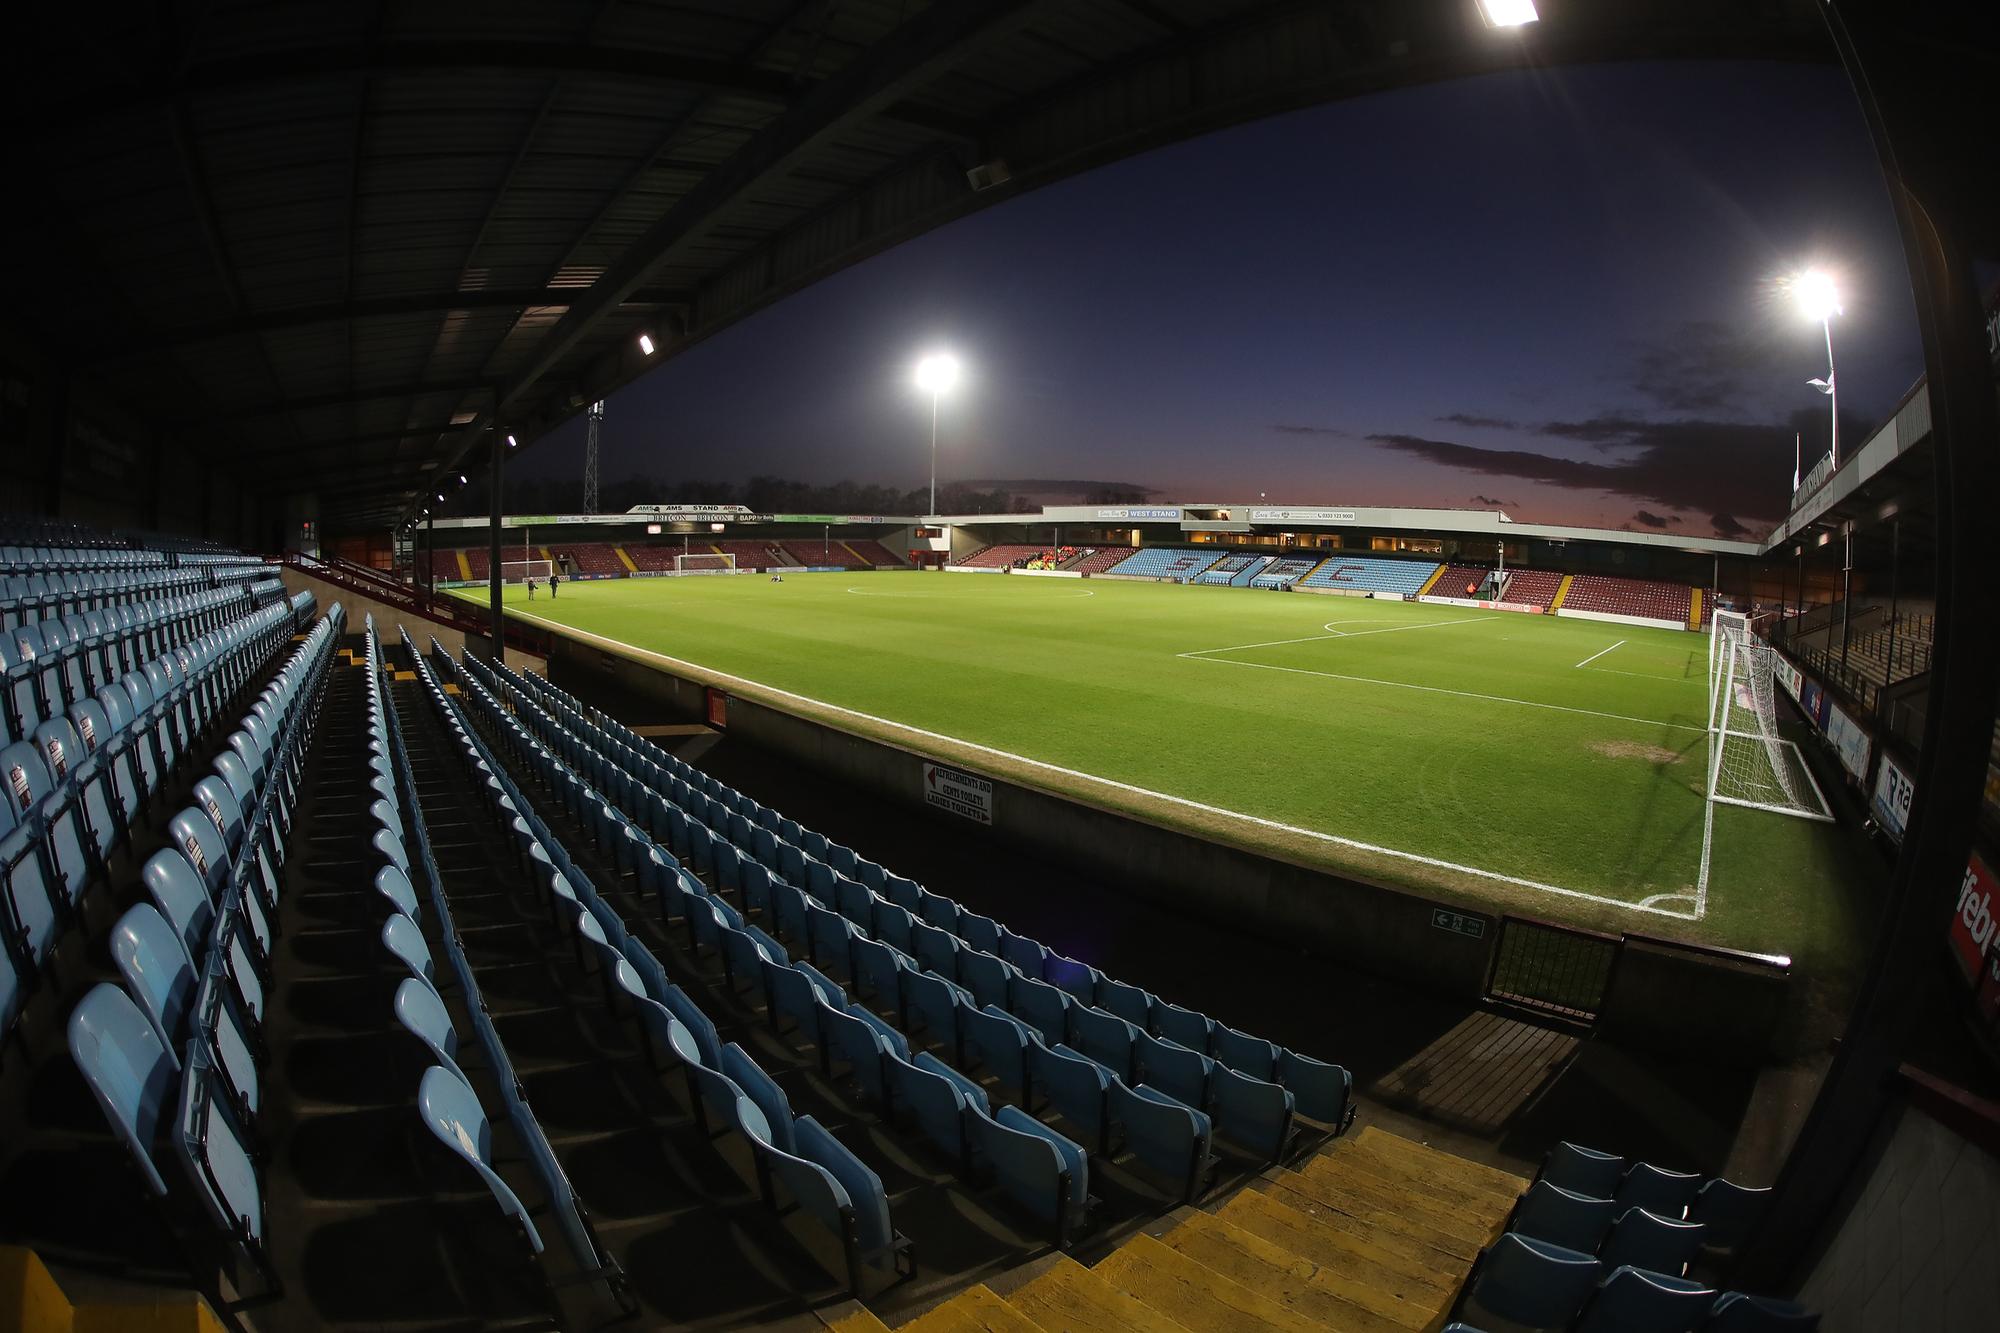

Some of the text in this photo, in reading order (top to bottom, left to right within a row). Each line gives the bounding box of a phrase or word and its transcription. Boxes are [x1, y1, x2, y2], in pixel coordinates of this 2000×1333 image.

[936, 767, 991, 793] REFRESHMENTS AND
[927, 793, 981, 819] LADIES TOILETS
[942, 784, 983, 806] GENTS TOILETS
